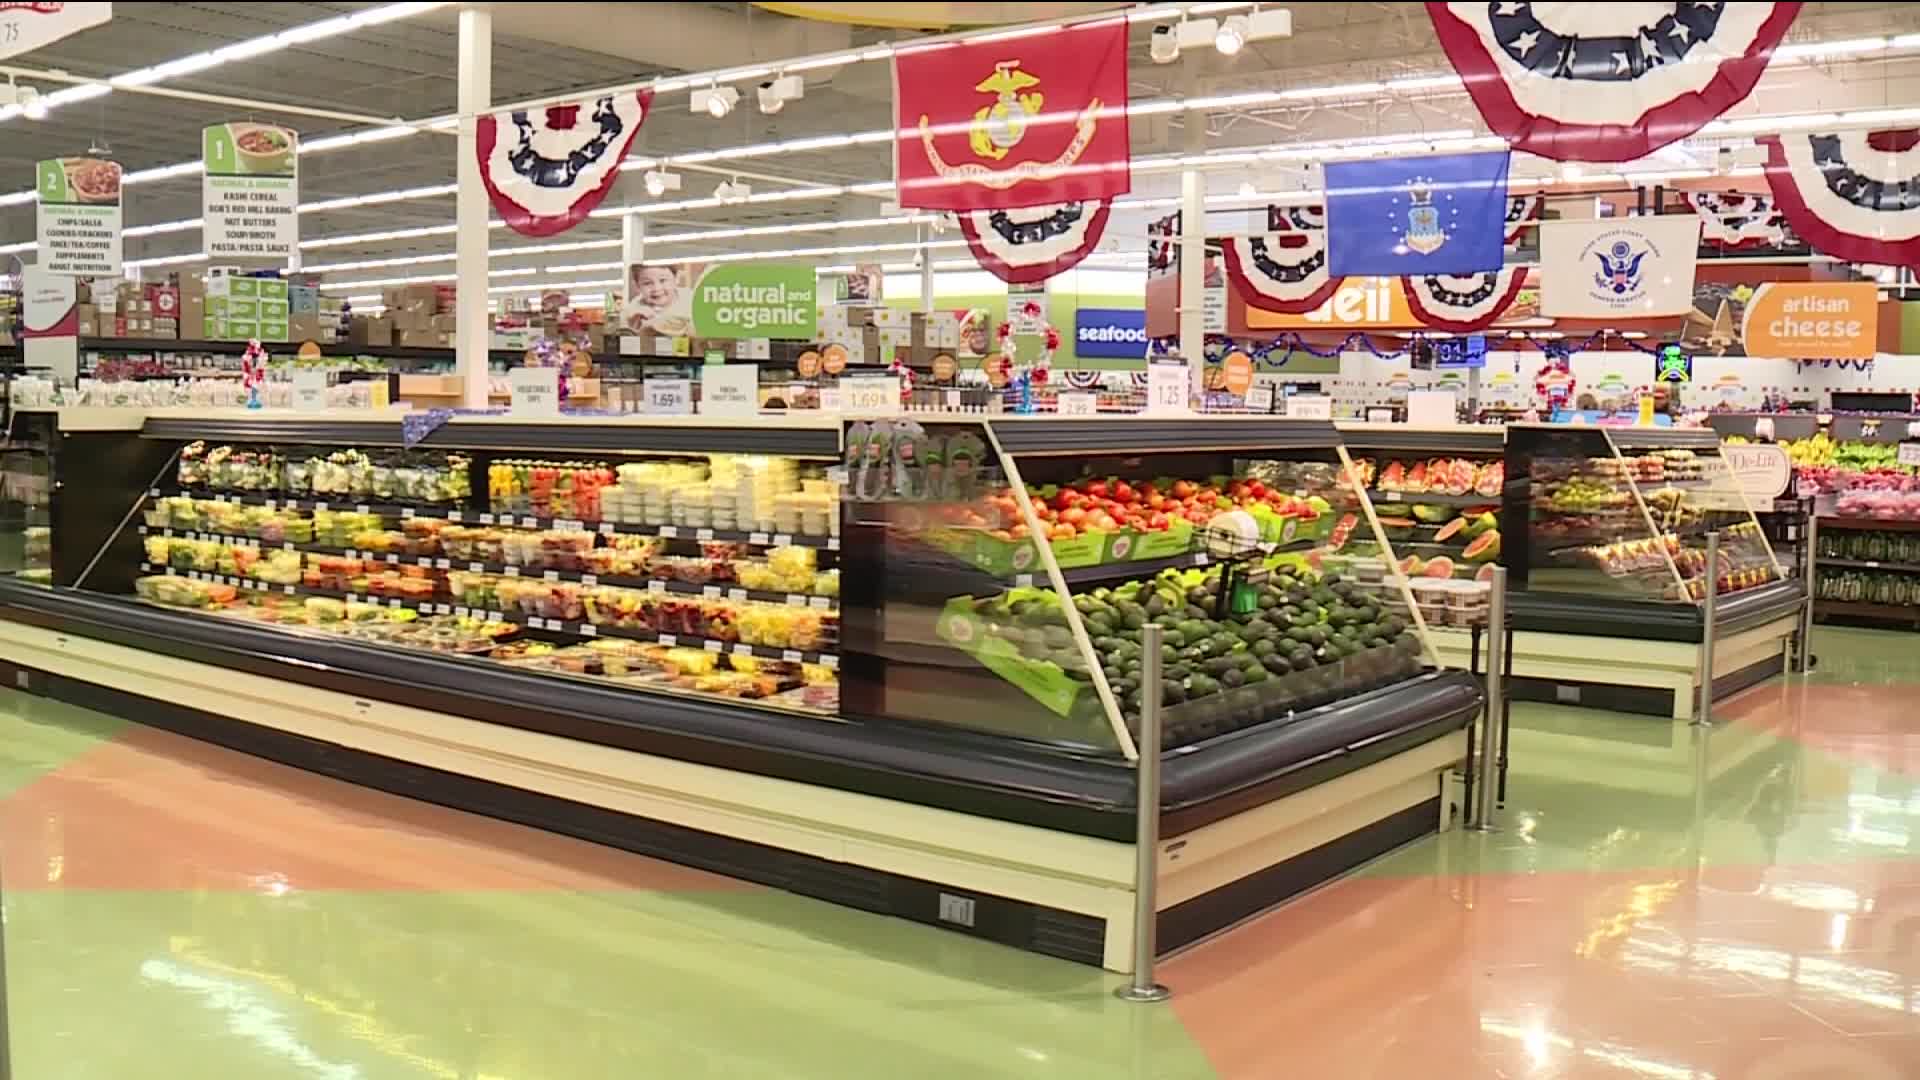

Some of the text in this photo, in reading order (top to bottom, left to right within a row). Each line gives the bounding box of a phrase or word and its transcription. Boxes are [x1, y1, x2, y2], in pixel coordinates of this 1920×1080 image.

[216, 140, 223, 160] 1
[47, 172, 57, 190] 2
[250, 192, 278, 201] CEREAL
[232, 205, 245, 213] RED
[224, 218, 277, 227] NUT BUTTERS
[55, 252, 105, 261] SUPPLEMENTS
[73, 263, 112, 272] NUTRITION
[703, 281, 812, 304] natural and
[1783, 295, 1849, 313] artisan
[716, 303, 809, 329] organic
[1079, 325, 1147, 342] seafood
[1769, 316, 1863, 337] cheese
[652, 393, 674, 407] 1.69
[852, 392, 879, 408] 1.69
